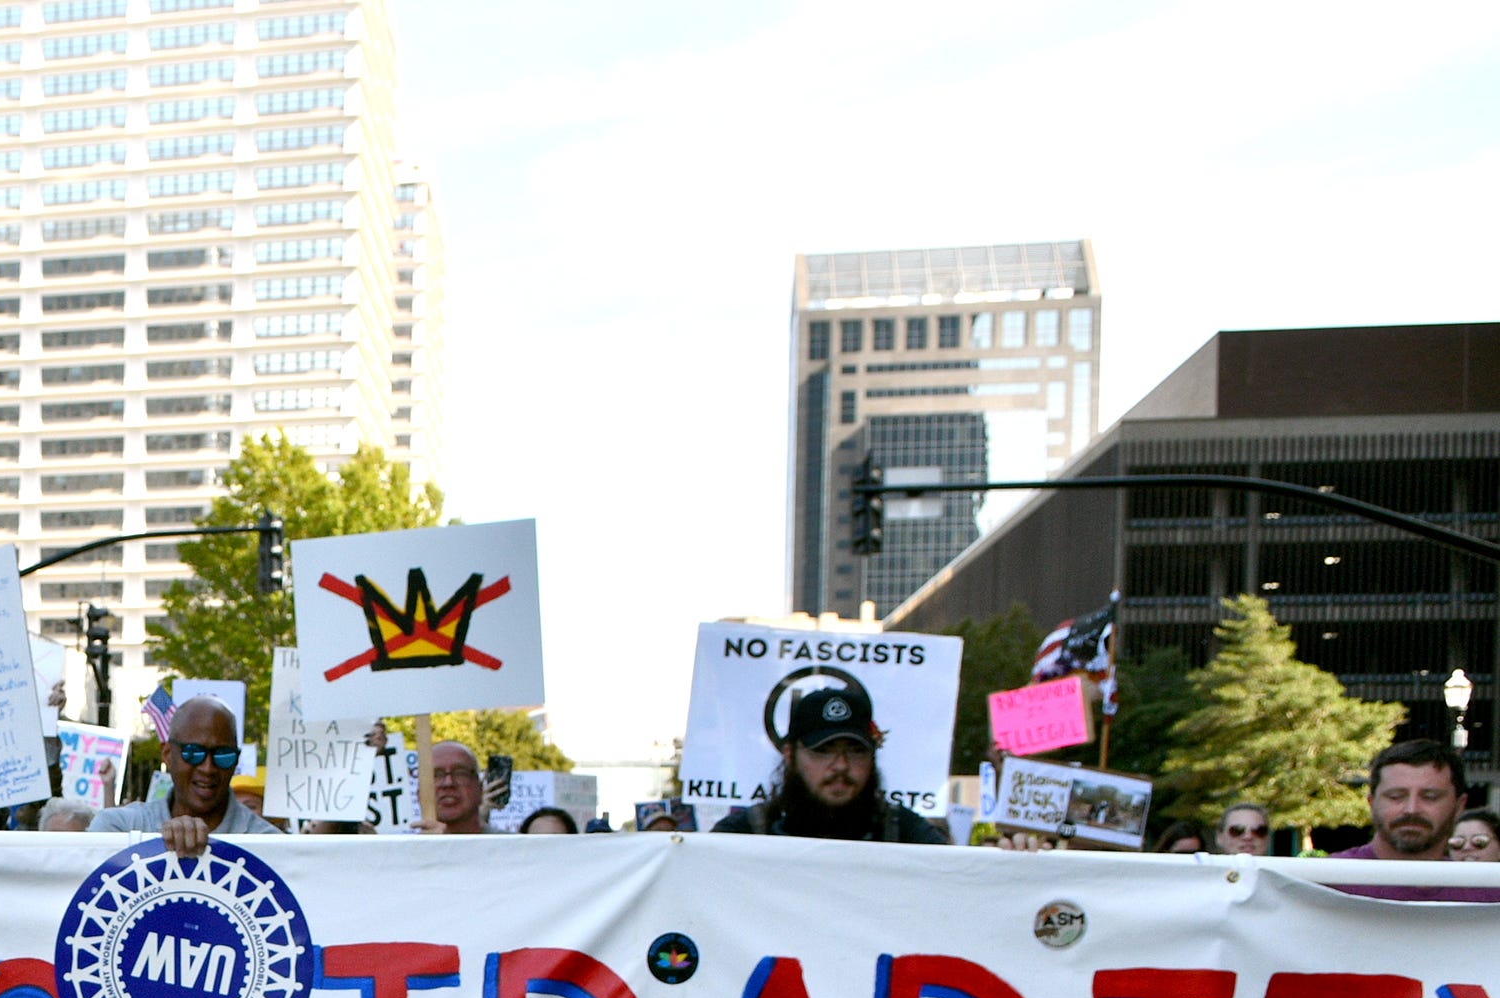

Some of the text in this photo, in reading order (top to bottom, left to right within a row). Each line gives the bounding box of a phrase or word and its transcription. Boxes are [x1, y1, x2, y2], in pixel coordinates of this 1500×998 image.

[725, 638, 925, 665] NO FASCISTS
[292, 718, 340, 735] IS A
[277, 737, 367, 775] PIRATE
[285, 773, 354, 812] KING
[688, 779, 742, 800] KILL
[128, 886, 165, 910] AMERICA
[116, 911, 128, 923] OF
[232, 903, 257, 931] UNITED
[1042, 911, 1085, 927] ASM
[102, 924, 119, 967] WORKERS
[130, 931, 237, 996] UAW
